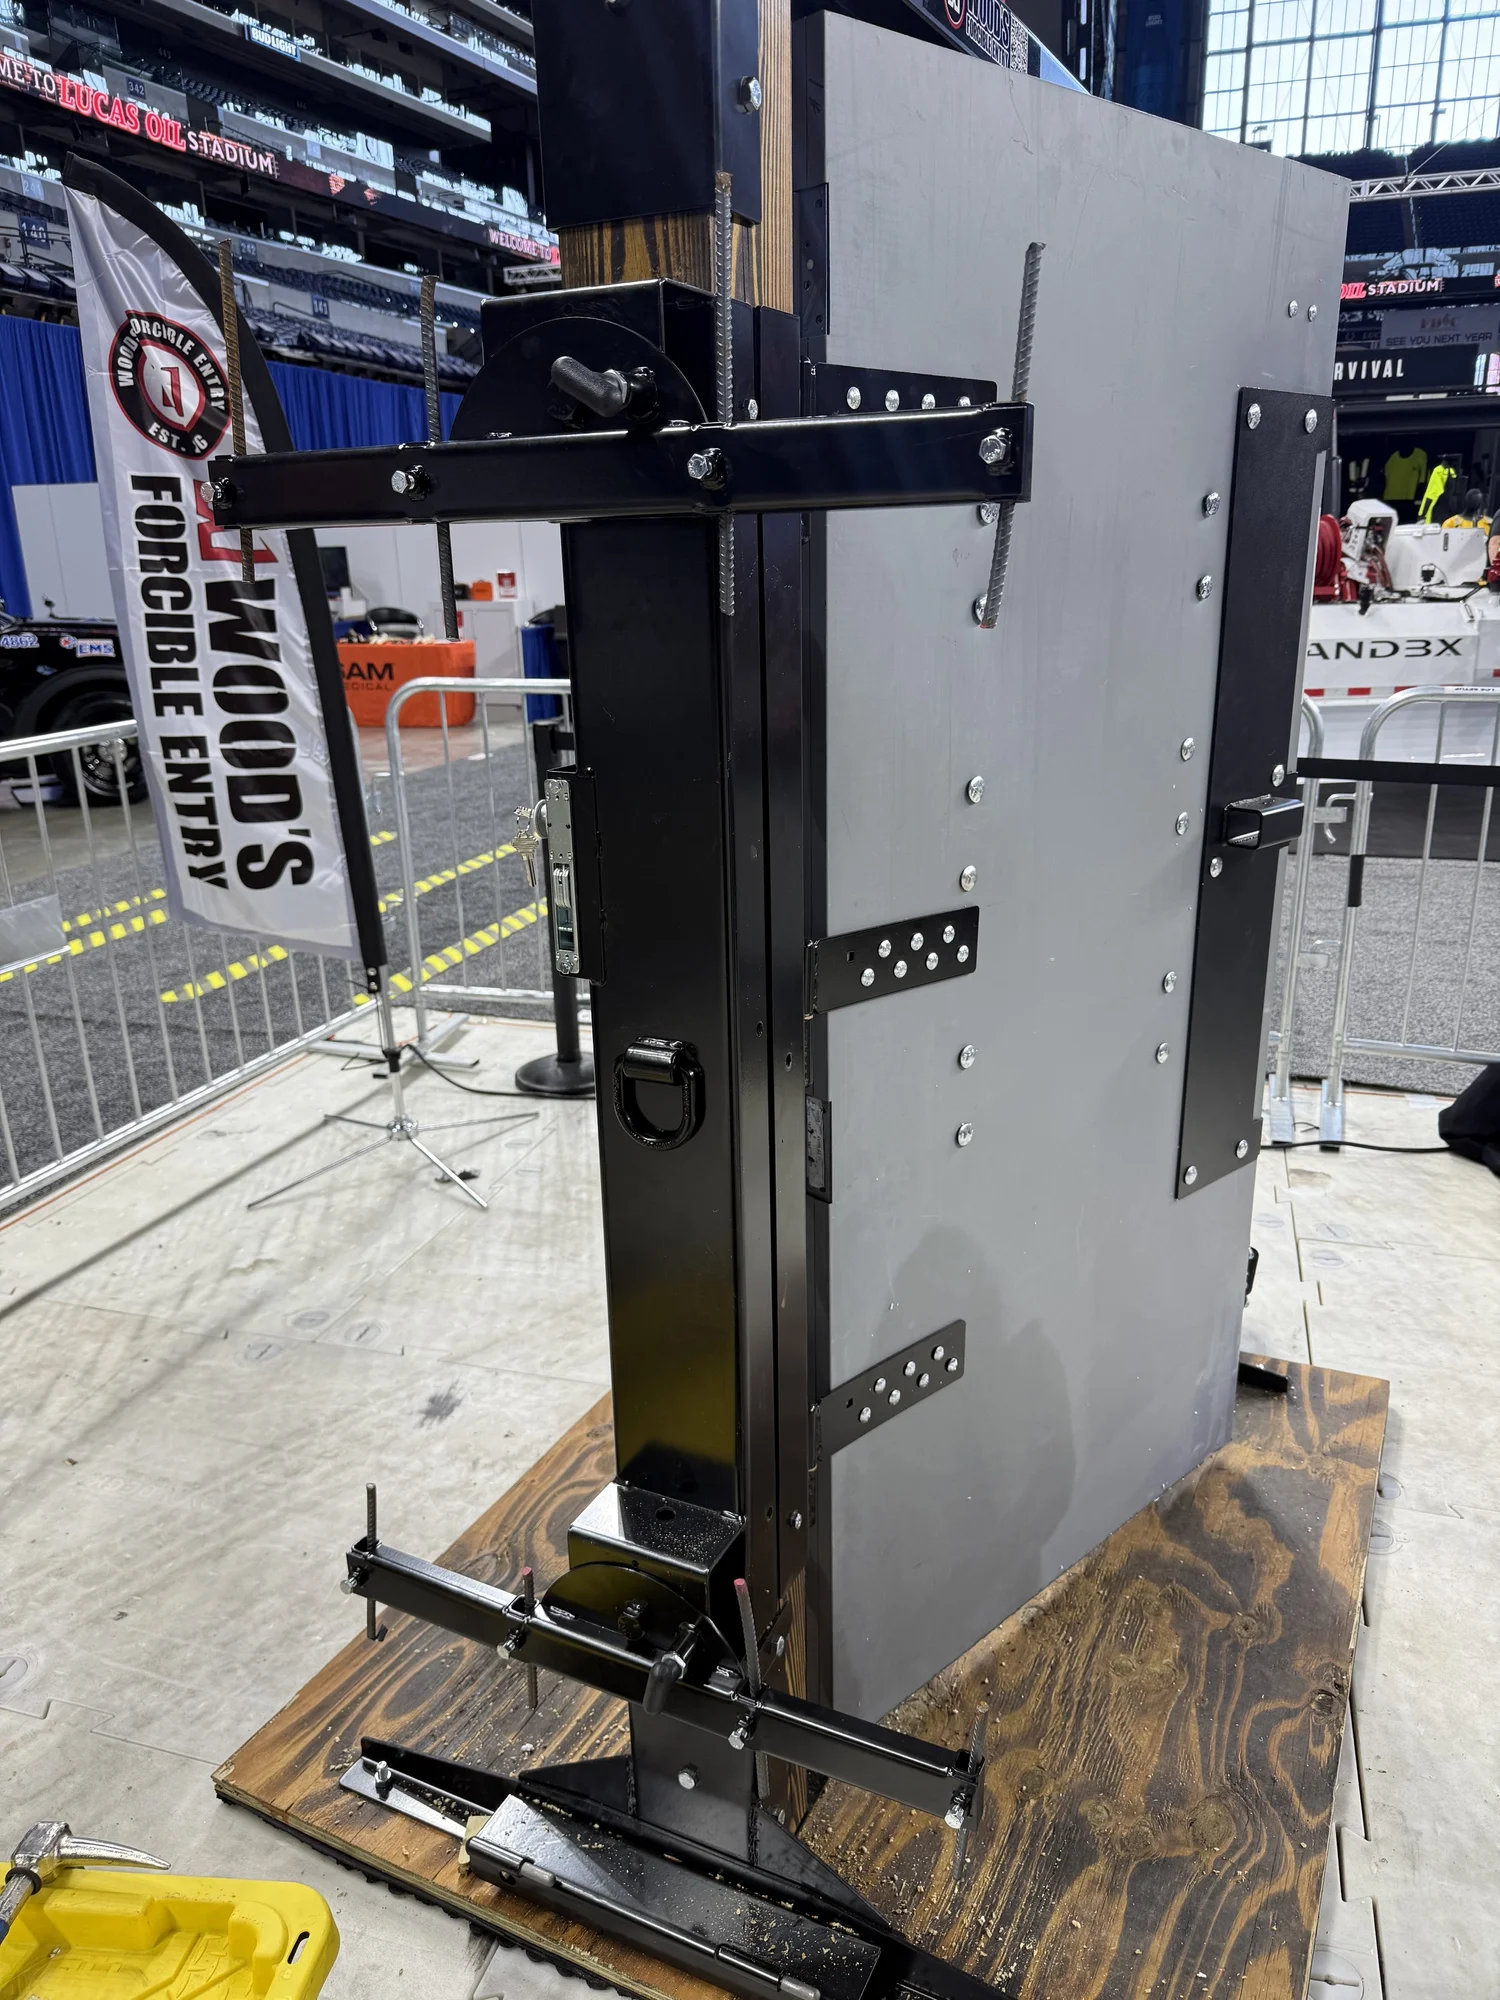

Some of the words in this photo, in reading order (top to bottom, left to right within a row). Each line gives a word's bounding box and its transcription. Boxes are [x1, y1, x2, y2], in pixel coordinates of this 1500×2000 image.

[252, 27, 271, 45] BUD
[271, 36, 297, 56] LIGHT
[966, 0, 1009, 49] OOD'S
[128, 81, 145, 95] 342
[30, 68, 56, 94] TO
[59, 74, 140, 133] LUCAS
[145, 110, 187, 152] OIL
[188, 130, 275, 175] STADIUM
[488, 227, 538, 257] WELCOME
[540, 246, 552, 261] TO
[1368, 279, 1440, 296] STADIUM
[1386, 337, 1406, 346] SEE
[1409, 335, 1431, 345] YOU
[1434, 333, 1461, 344] NEXT
[1464, 332, 1493, 342] YEAR
[193, 353, 226, 412] ENTRY
[1334, 358, 1404, 381] RVIVAL
[130, 474, 205, 719] FORCIBLE
[79, 643, 114, 655] EMS
[204, 579, 315, 891] WOOD'S
[159, 735, 230, 891] ENTRY
